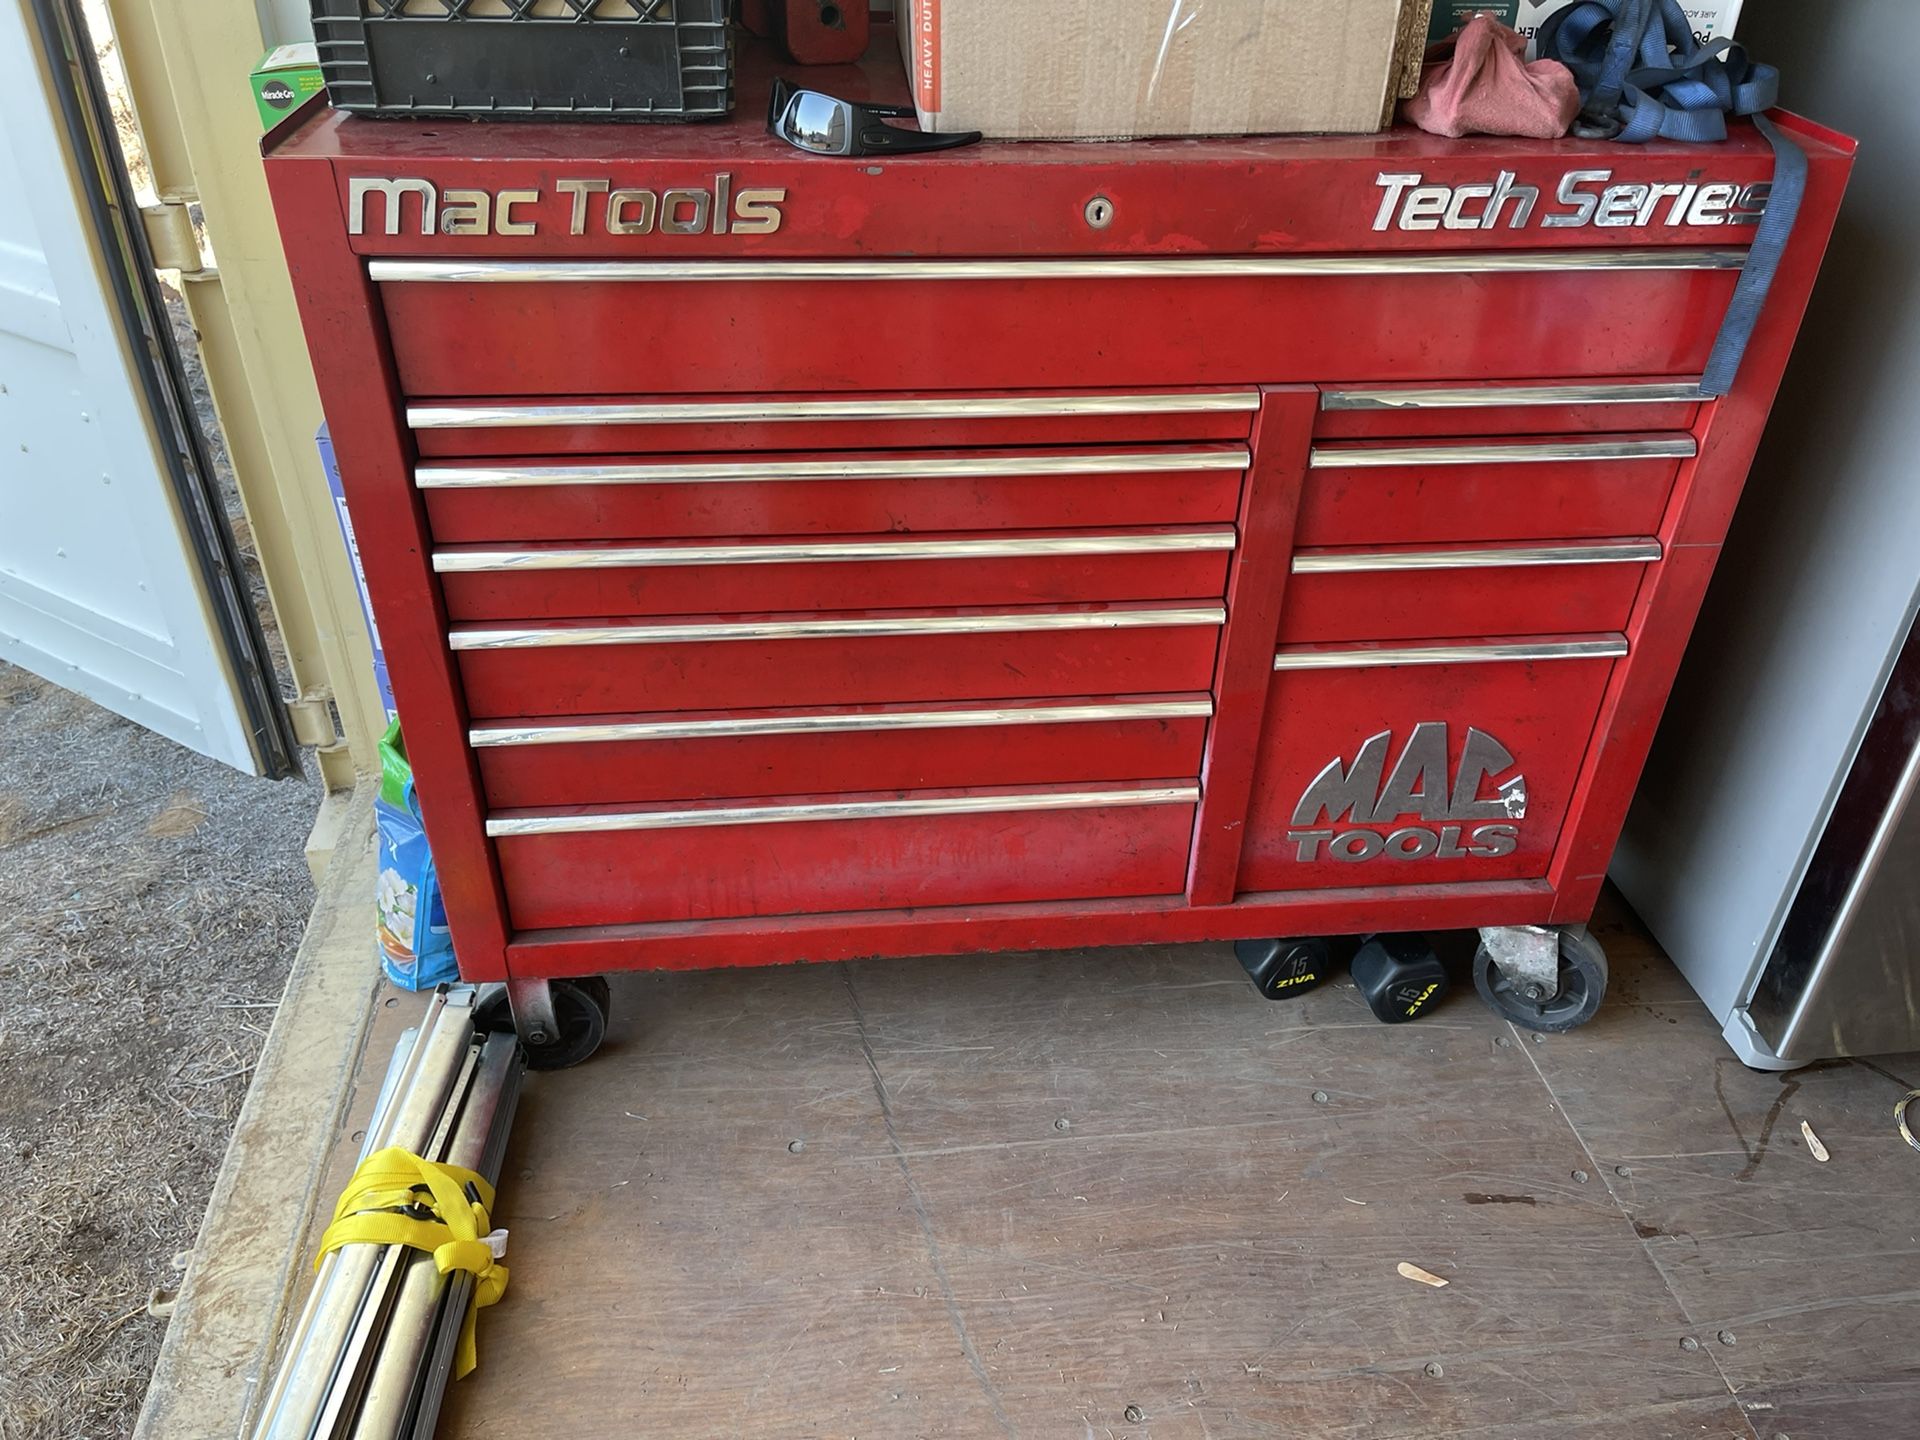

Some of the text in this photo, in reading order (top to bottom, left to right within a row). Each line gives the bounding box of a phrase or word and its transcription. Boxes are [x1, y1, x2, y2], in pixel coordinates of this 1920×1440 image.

[923, 39, 934, 89] HEAVY
[556, 172, 787, 235] Tools
[1372, 169, 1773, 231] Tech Series
[1290, 721, 1528, 826] MAC
[1288, 824, 1519, 862] TOOLS
[1276, 973, 1316, 988] ZIVA
[1291, 956, 1308, 976] 15
[1397, 987, 1421, 1003] 15
[1406, 983, 1439, 1016] ZIVA
